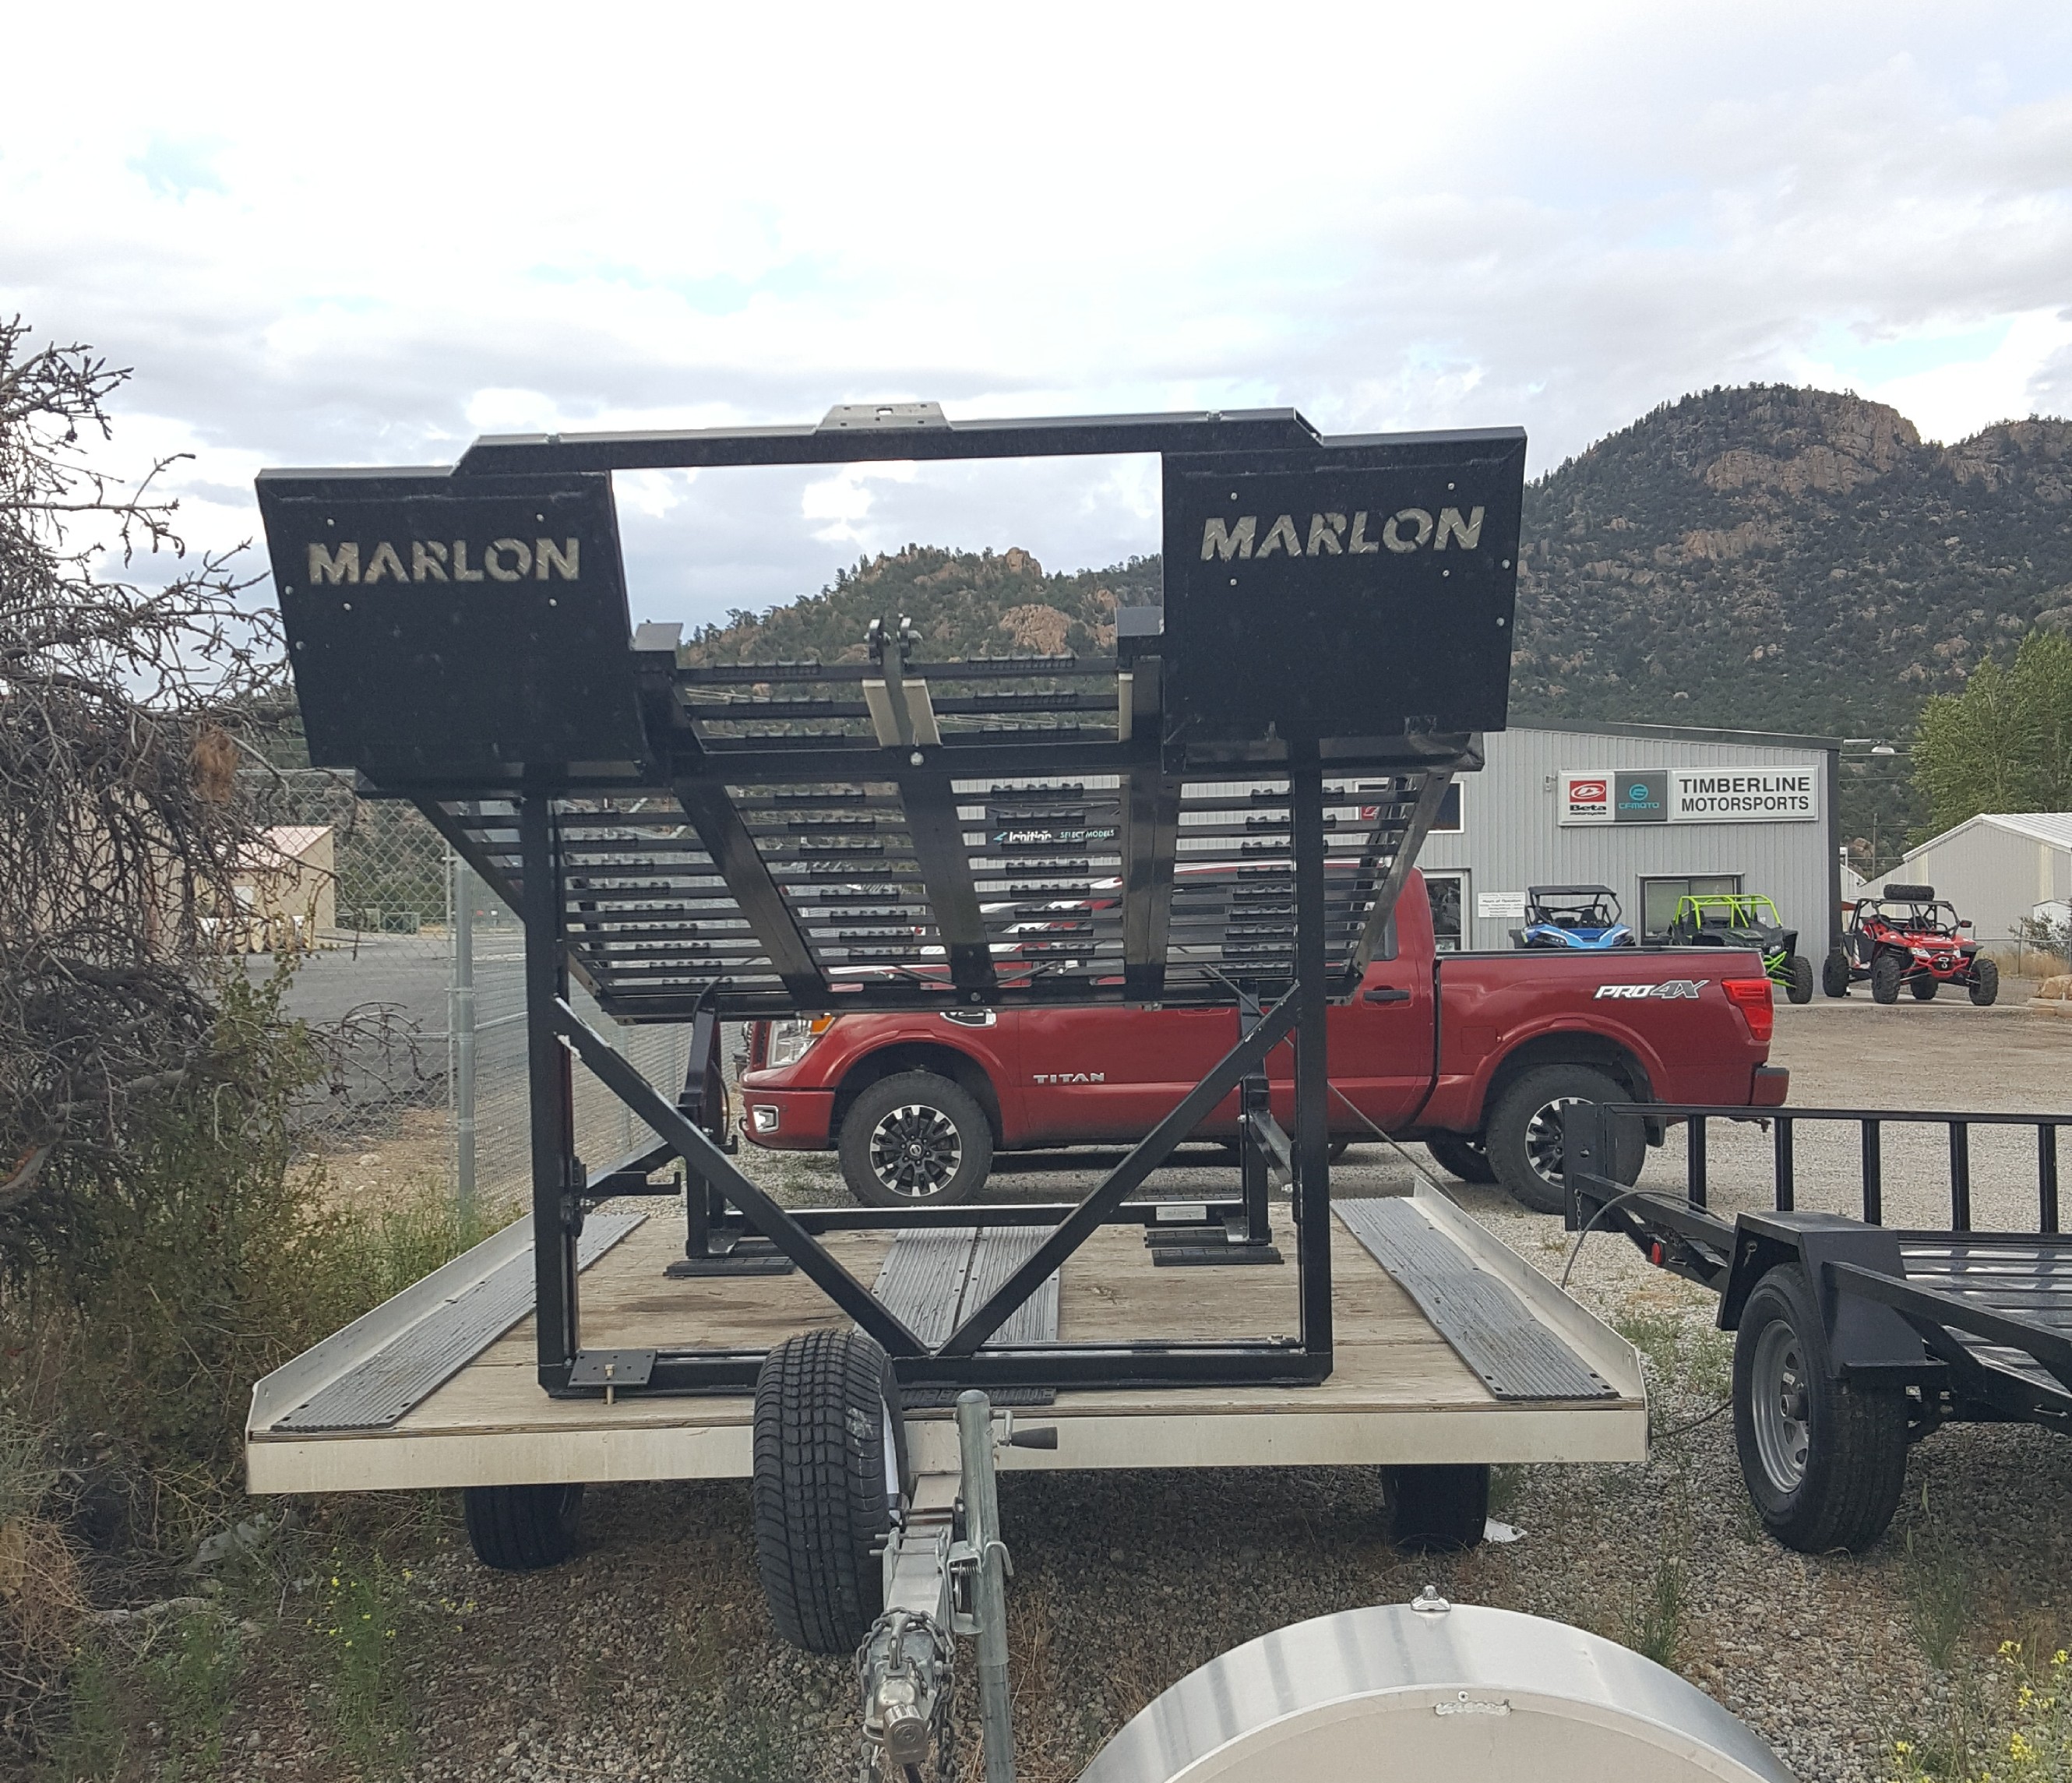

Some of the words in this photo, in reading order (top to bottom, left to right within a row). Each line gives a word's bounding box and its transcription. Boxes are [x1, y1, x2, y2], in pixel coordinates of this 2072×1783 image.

[1200, 506, 1485, 562] MARLON
[308, 537, 580, 586] MARLON
[1679, 777, 1810, 794] TIMBERLINE
[1681, 796, 1809, 812] MOTORSPORTS
[1085, 829, 1115, 839] MODELS
[1033, 1073, 1105, 1084] TITAN
